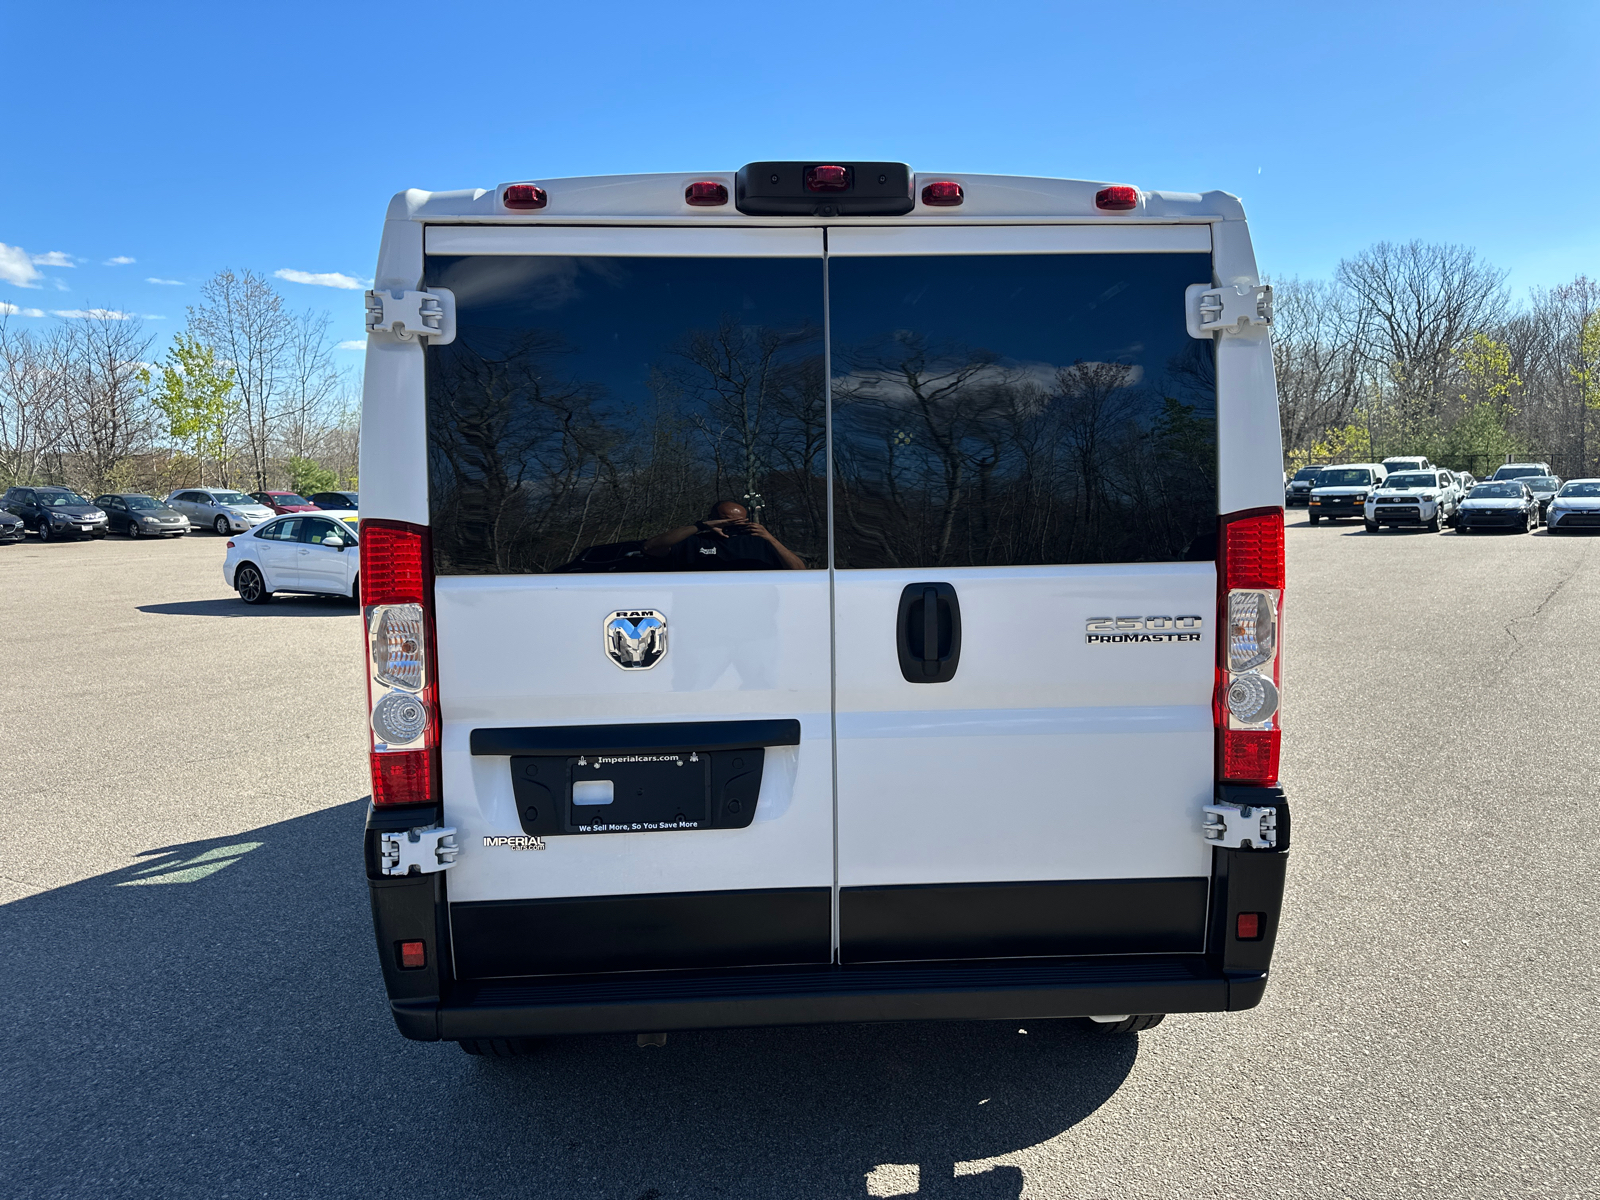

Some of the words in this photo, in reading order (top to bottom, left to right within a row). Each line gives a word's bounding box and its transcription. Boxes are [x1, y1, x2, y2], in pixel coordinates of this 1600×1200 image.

[1085, 615, 1202, 631] 2500
[598, 755, 679, 764] Imperialcars.com
[609, 823, 630, 831] More,
[660, 821, 677, 829] Save
[483, 836, 545, 846] IMPERIAL
